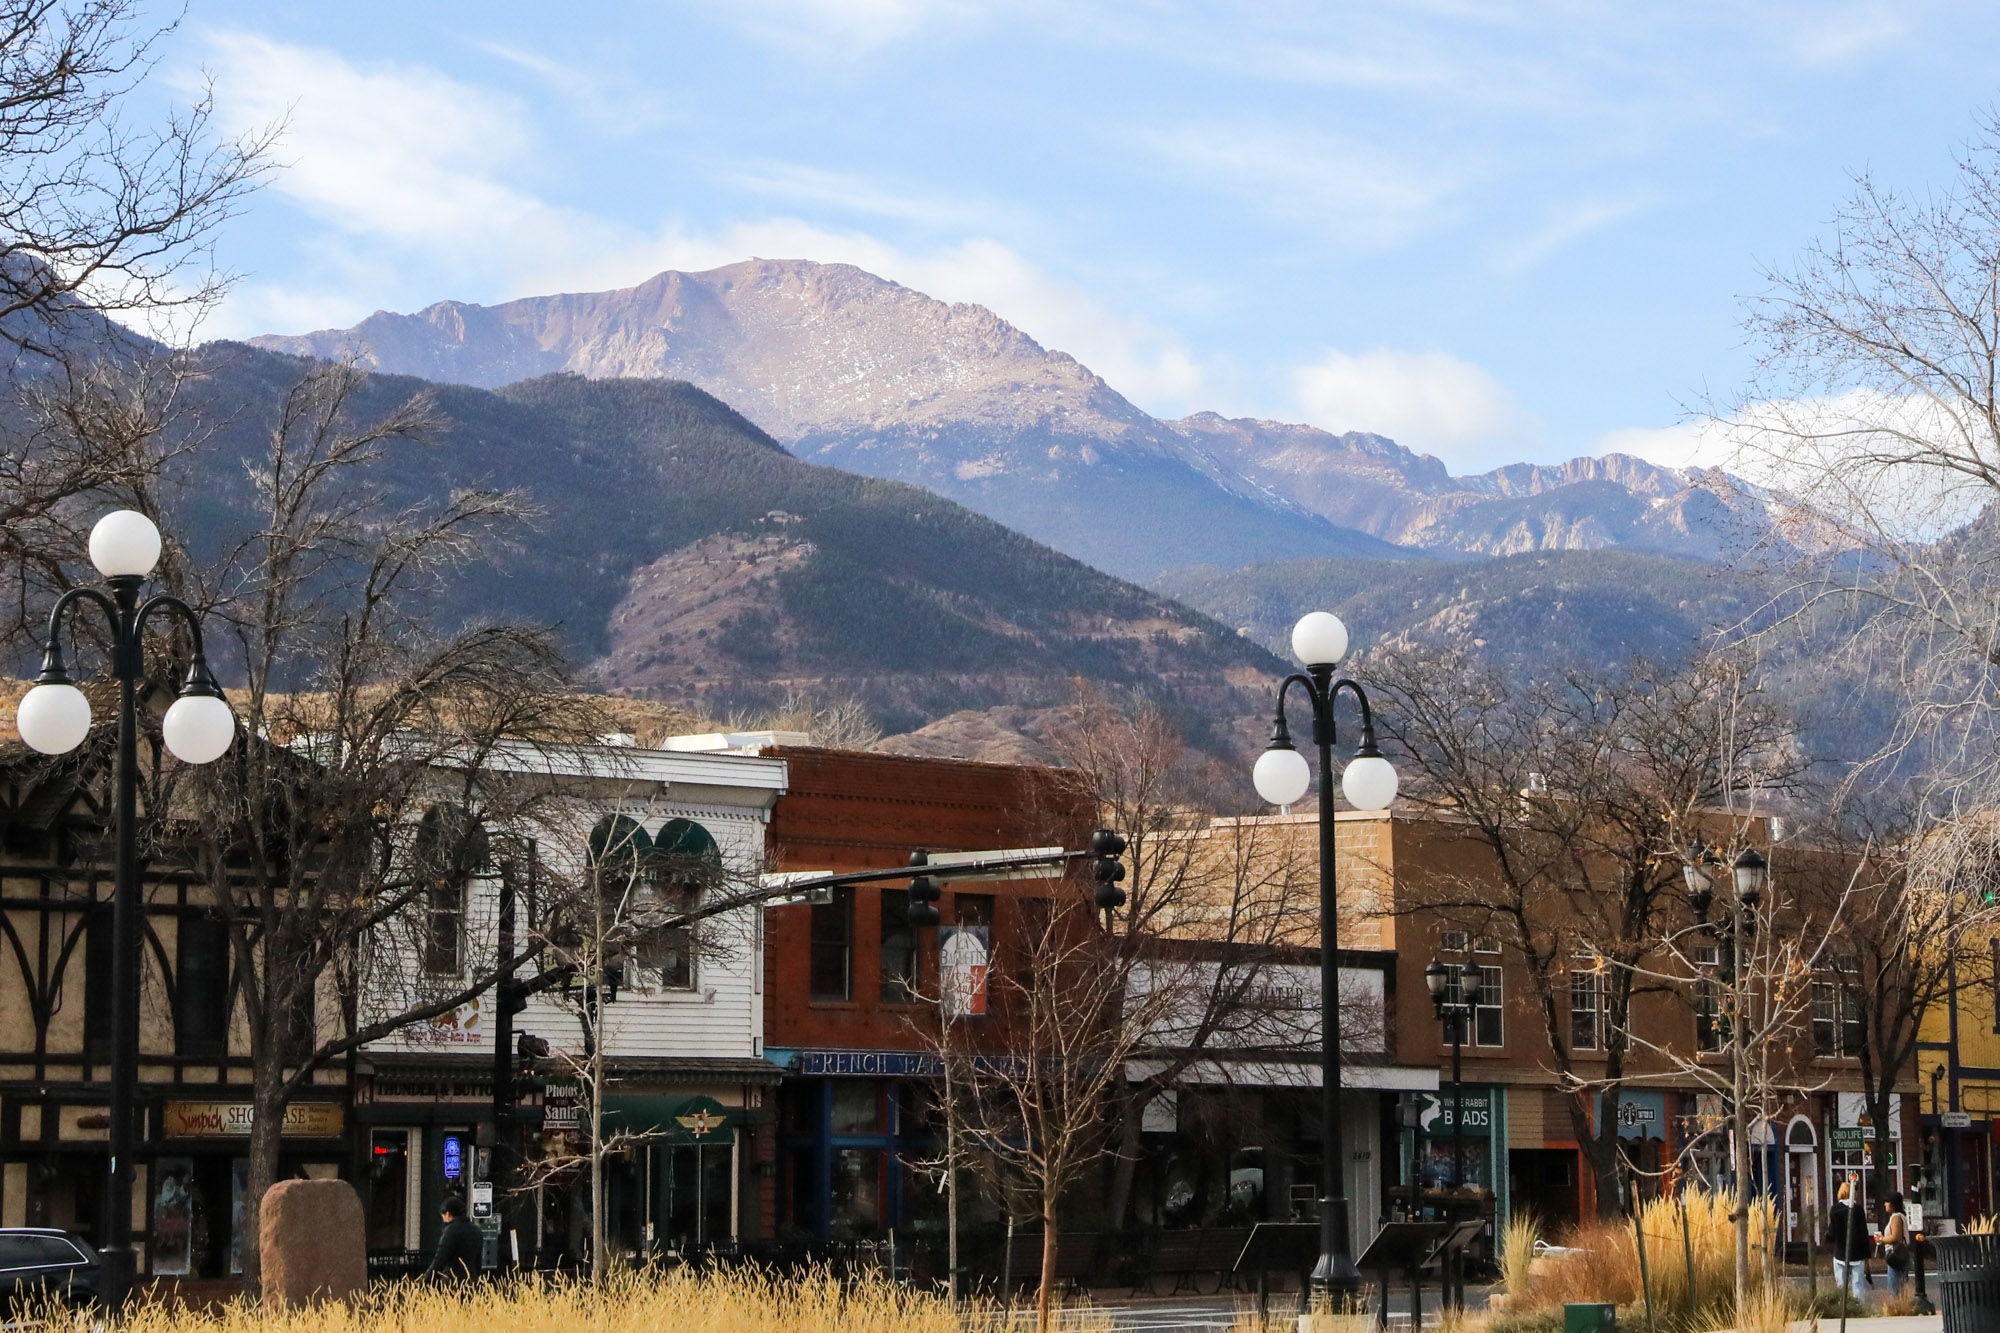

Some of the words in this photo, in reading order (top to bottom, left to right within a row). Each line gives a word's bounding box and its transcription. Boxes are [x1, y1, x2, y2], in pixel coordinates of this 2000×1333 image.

[810, 1054, 887, 1073] FRENCH
[453, 1083, 500, 1096] BUTTO
[545, 1084, 578, 1098] Photos
[1443, 1098, 1464, 1107] WHE
[1465, 1098, 1488, 1107] RABBIT
[177, 1102, 227, 1136] Simpich
[228, 1106, 306, 1124] SHOASE
[545, 1104, 578, 1120] Santa
[1444, 1110, 1489, 1126] BADS
[1832, 1130, 1847, 1140] CBD
[1847, 1129, 1862, 1139] LIFE
[1836, 1140, 1860, 1148] Kratom
